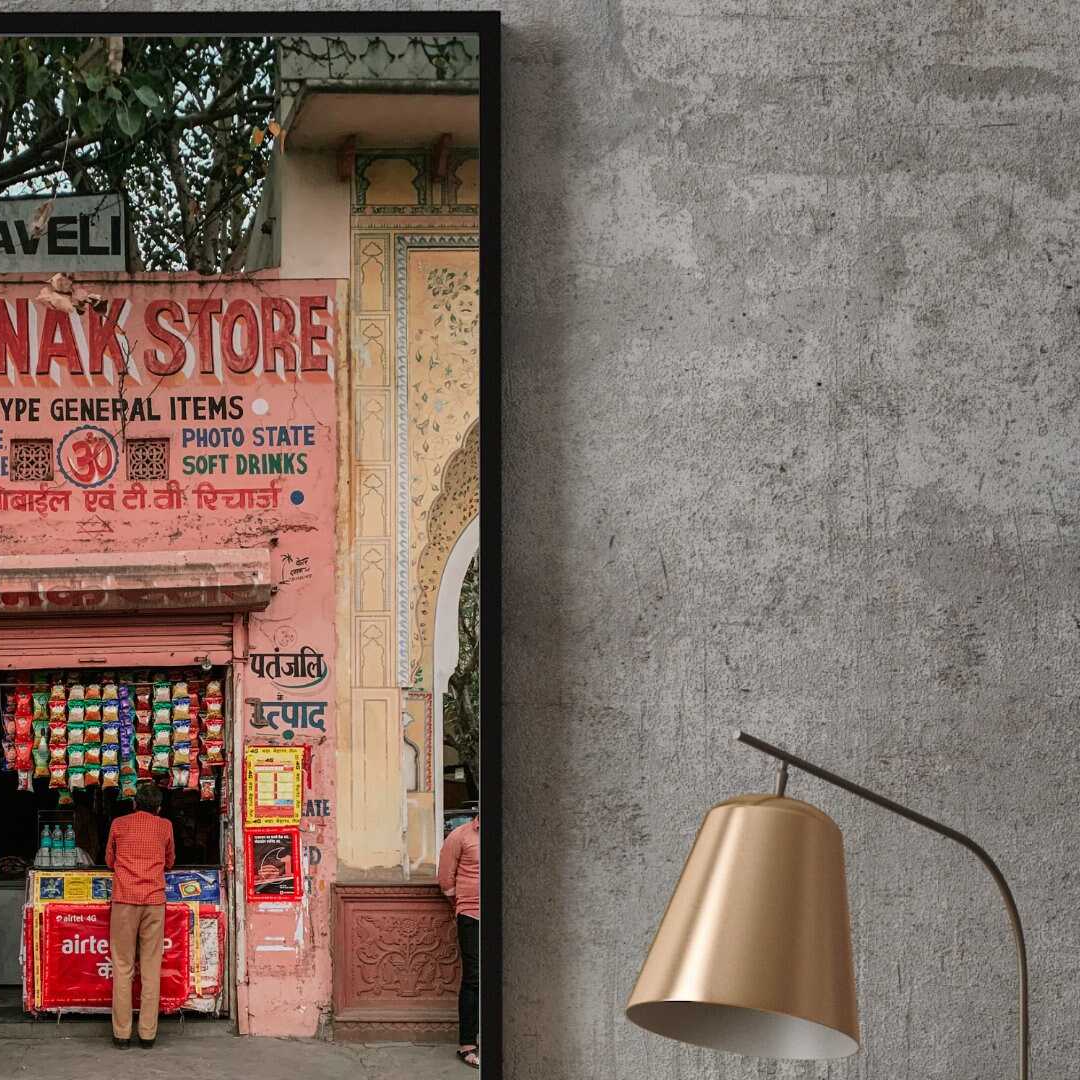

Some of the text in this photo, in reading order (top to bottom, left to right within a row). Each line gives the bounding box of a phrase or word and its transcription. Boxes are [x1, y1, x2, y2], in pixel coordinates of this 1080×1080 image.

[144, 296, 332, 379] STORE
[50, 398, 161, 421] GENERAL
[170, 396, 244, 421] ITEMS
[182, 425, 316, 448] PHOTO STATE
[182, 453, 308, 475] SOFT DRINKS
[82, 483, 117, 513] एवं
[192, 477, 283, 511] रिचार्ज
[250, 646, 324, 680] पतंजलि
[250, 702, 328, 733] उत्पाद
[63, 914, 83, 922] airtel
[61, 933, 109, 954] airte
